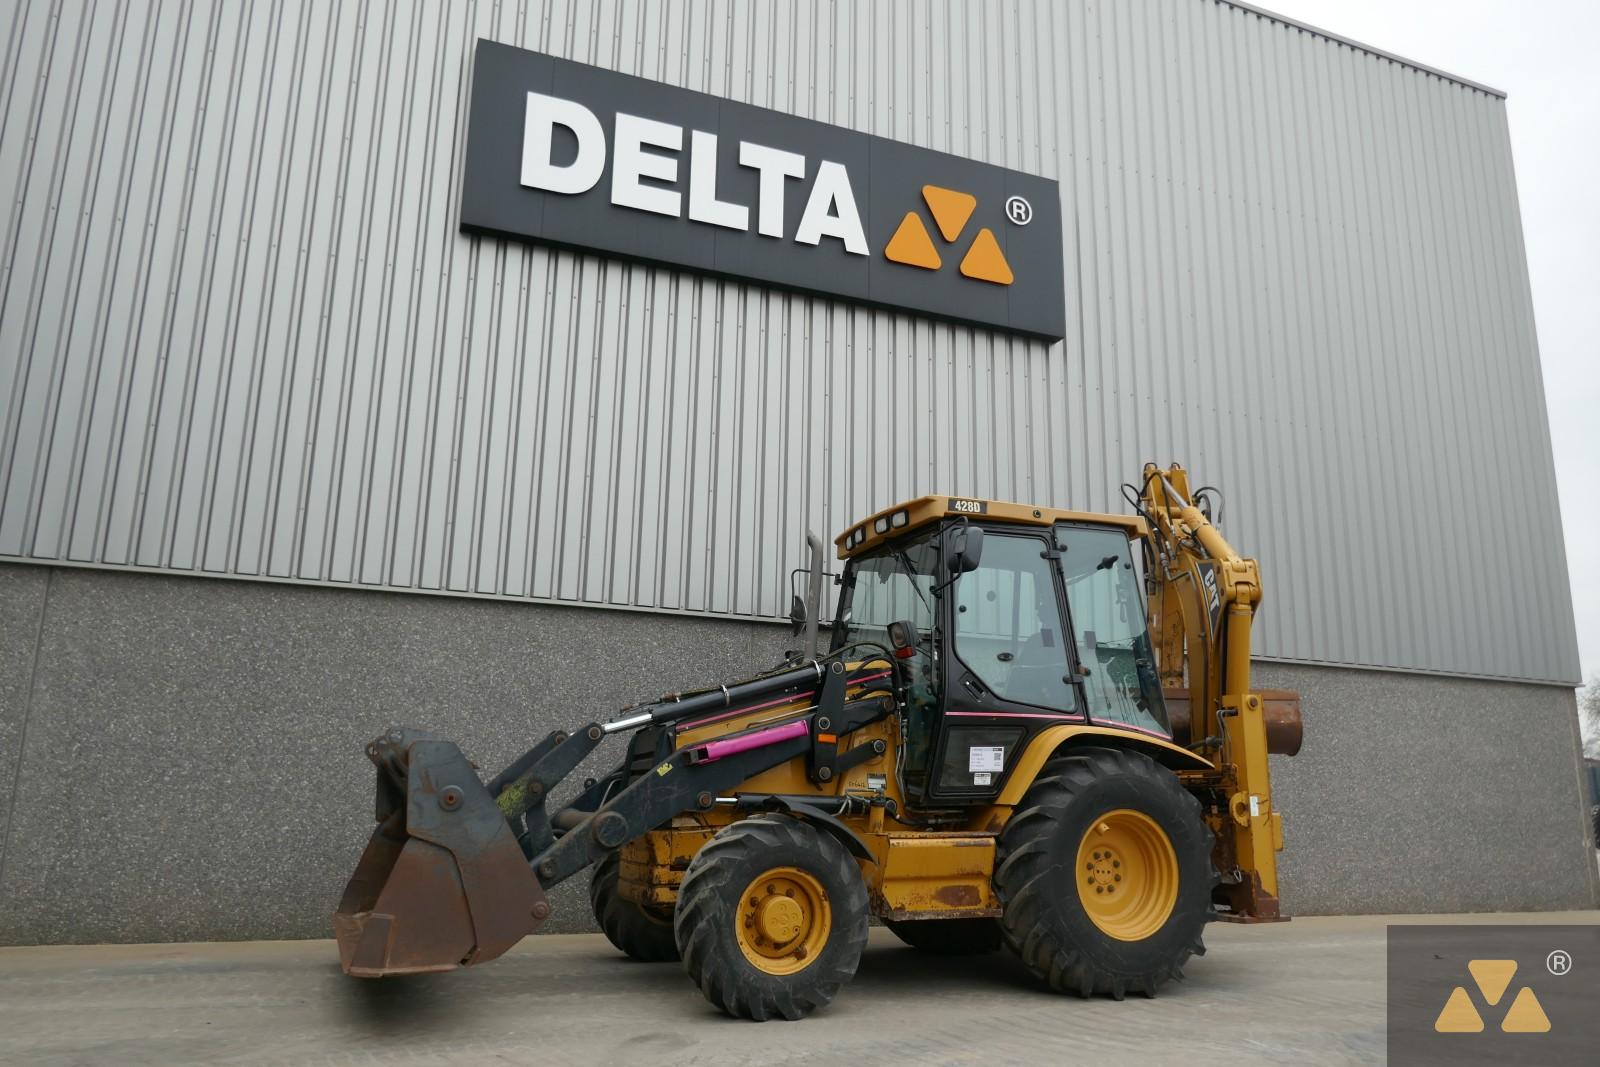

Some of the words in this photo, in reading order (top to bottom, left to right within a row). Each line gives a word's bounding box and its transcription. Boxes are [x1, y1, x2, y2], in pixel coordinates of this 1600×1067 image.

[520, 91, 871, 257] DELTA
[955, 500, 981, 513] 428D
[1204, 568, 1220, 612] CAT
